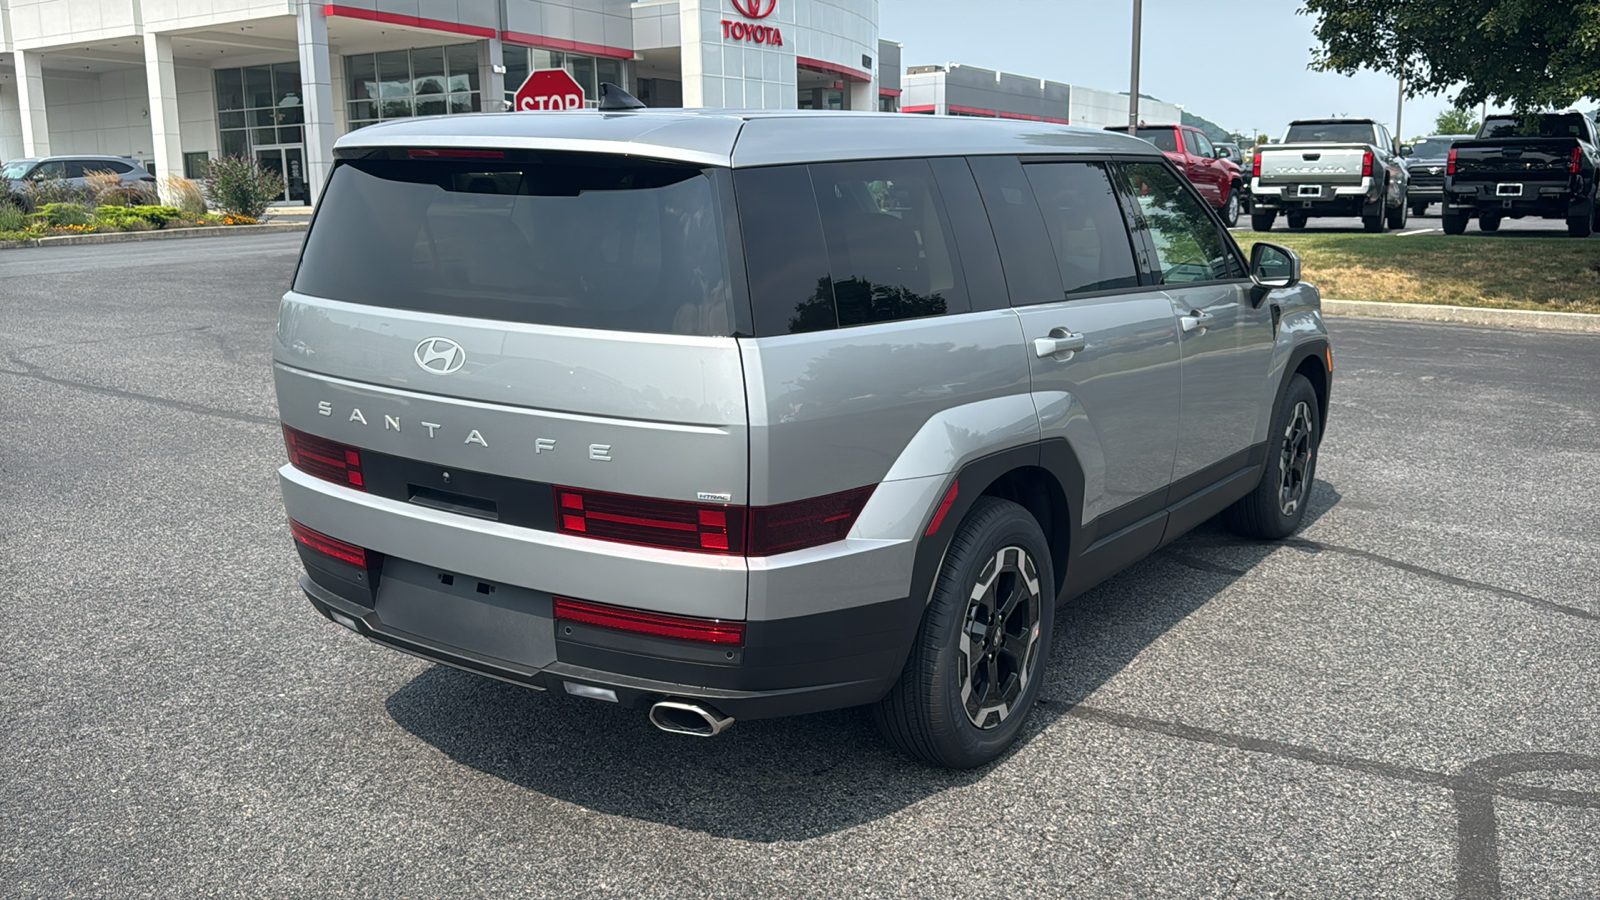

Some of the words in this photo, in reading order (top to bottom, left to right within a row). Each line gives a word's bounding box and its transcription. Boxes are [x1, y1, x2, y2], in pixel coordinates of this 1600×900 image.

[720, 19, 783, 46] TOYOTA
[521, 94, 580, 110] STOP
[1275, 166, 1347, 174] TACOMA
[318, 400, 488, 447] SANTA
[535, 438, 612, 461] FE
[698, 493, 730, 501] HTRAC
